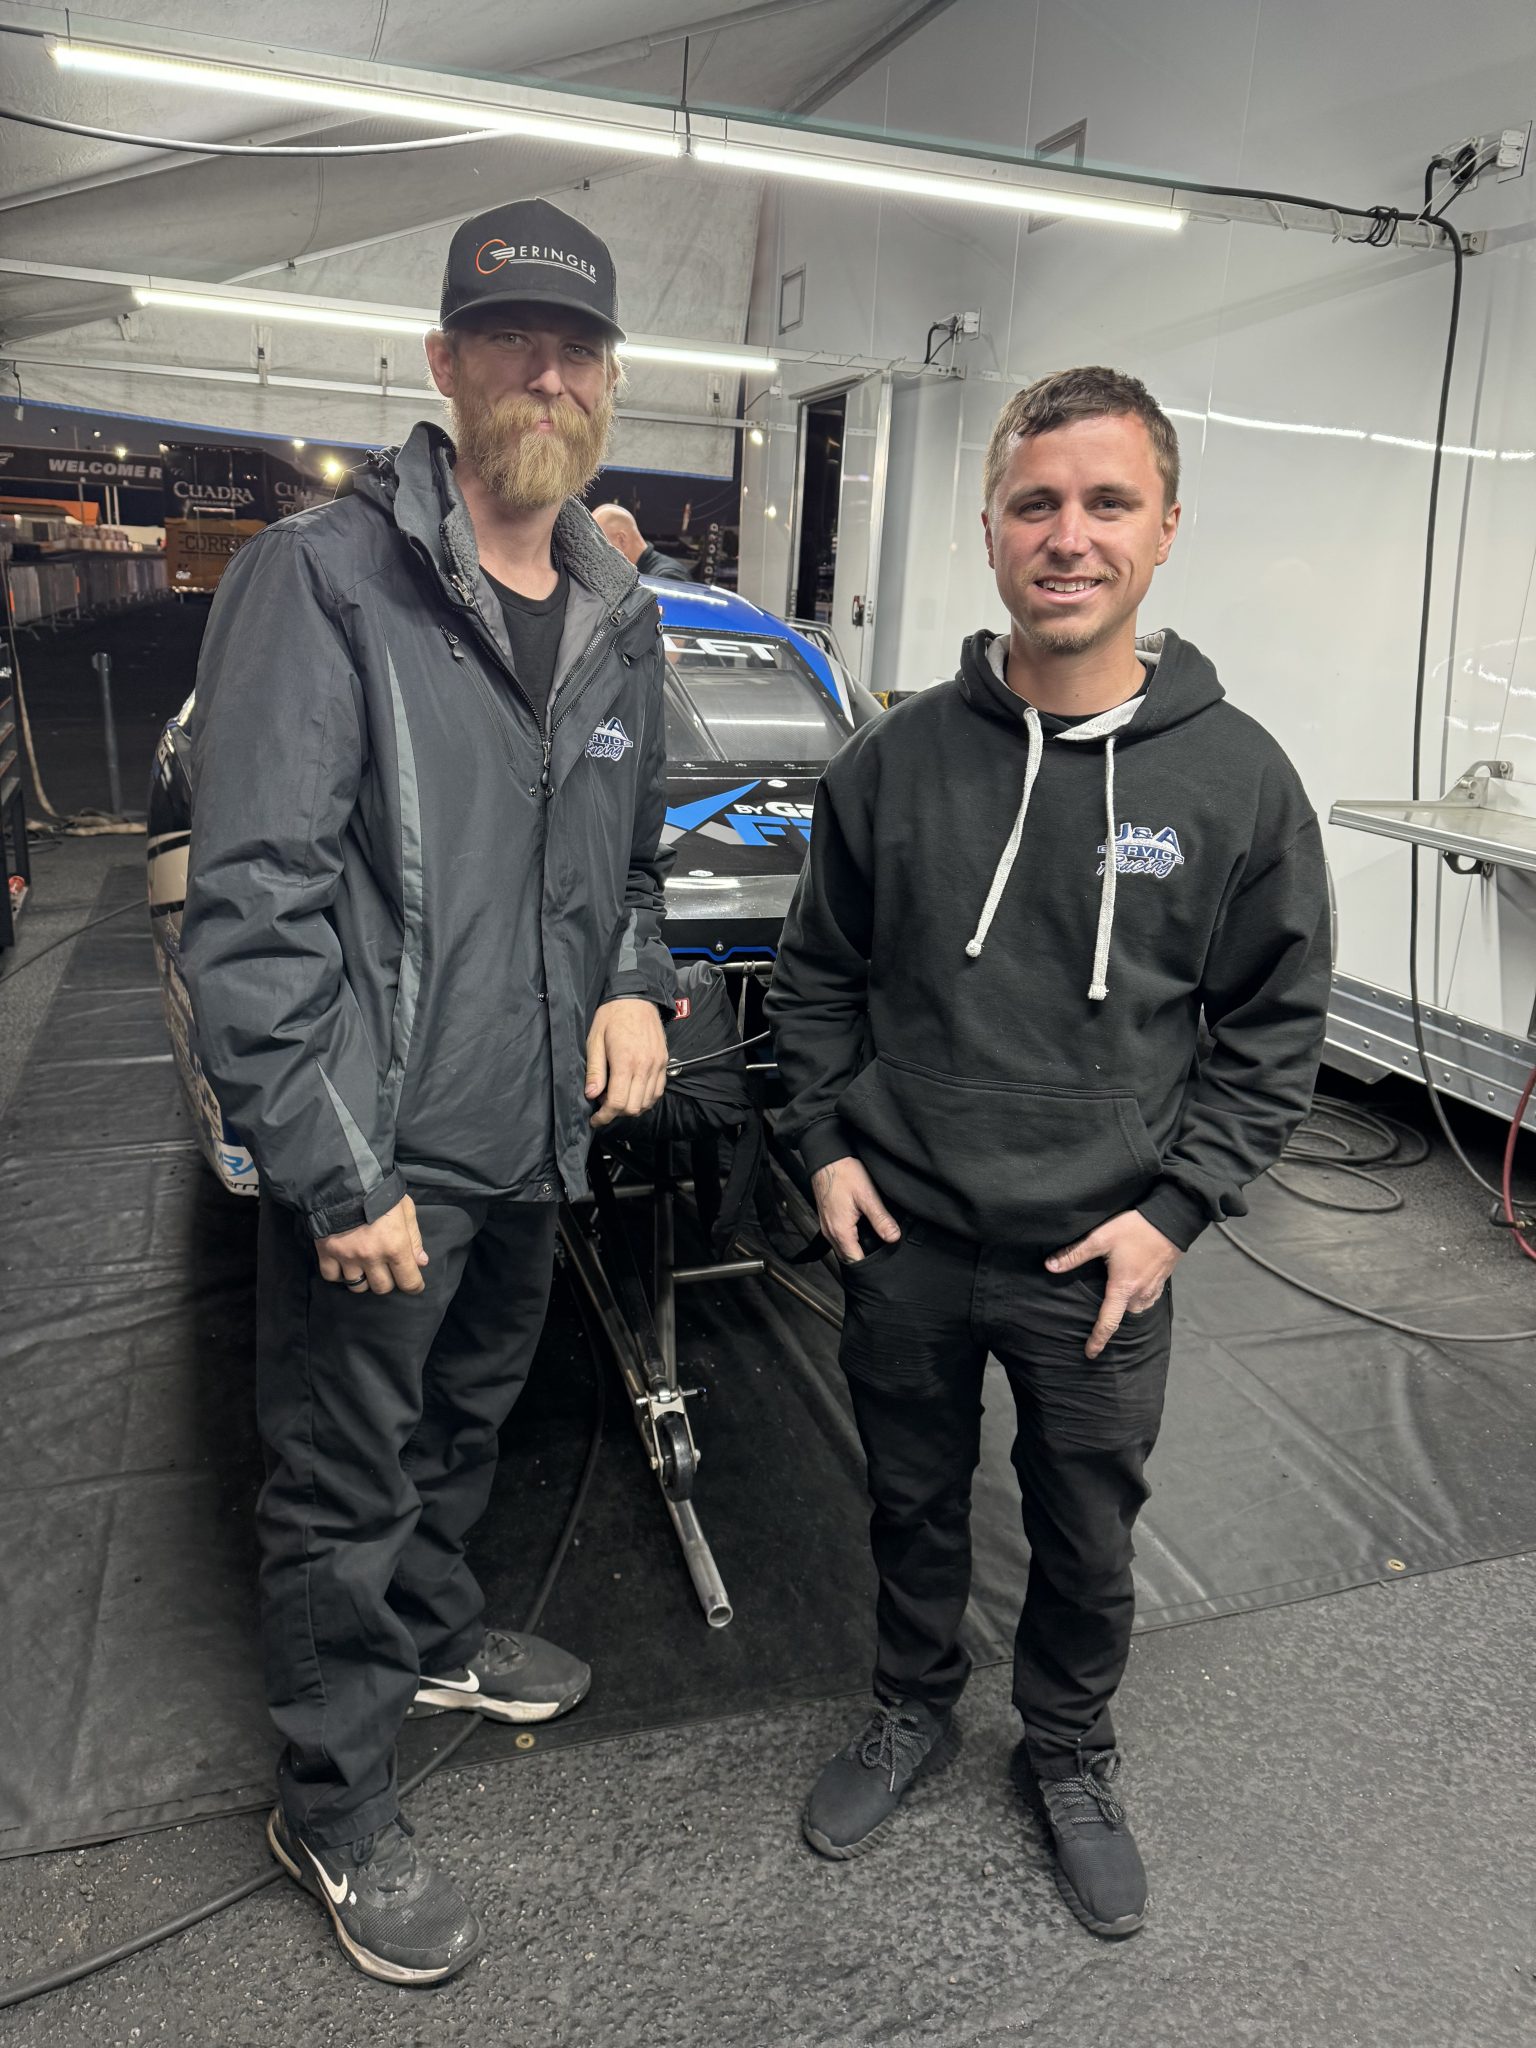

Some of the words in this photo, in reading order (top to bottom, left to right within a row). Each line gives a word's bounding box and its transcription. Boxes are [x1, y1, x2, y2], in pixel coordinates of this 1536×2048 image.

[49, 458, 146, 478] WELCOME
[173, 481, 256, 504] CUADRA
[733, 804, 764, 815] BY
